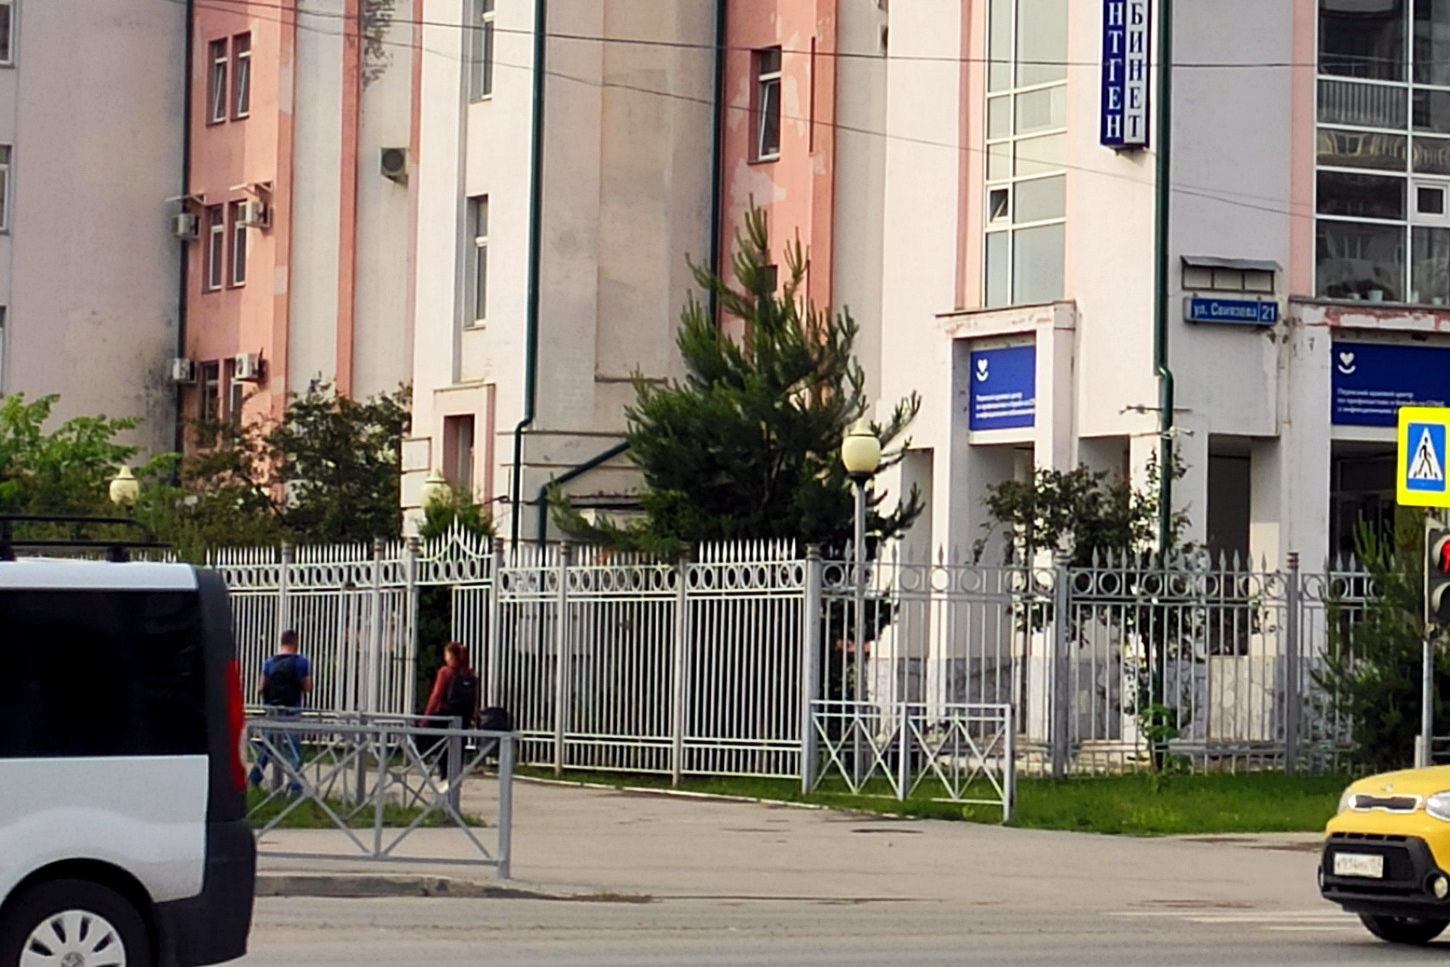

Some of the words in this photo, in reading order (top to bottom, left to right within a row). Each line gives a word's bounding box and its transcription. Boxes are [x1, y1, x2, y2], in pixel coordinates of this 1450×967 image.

[1194, 304, 1208, 317] ул.
[1211, 302, 1257, 318] Свиязева
[1261, 305, 1275, 320] 21
